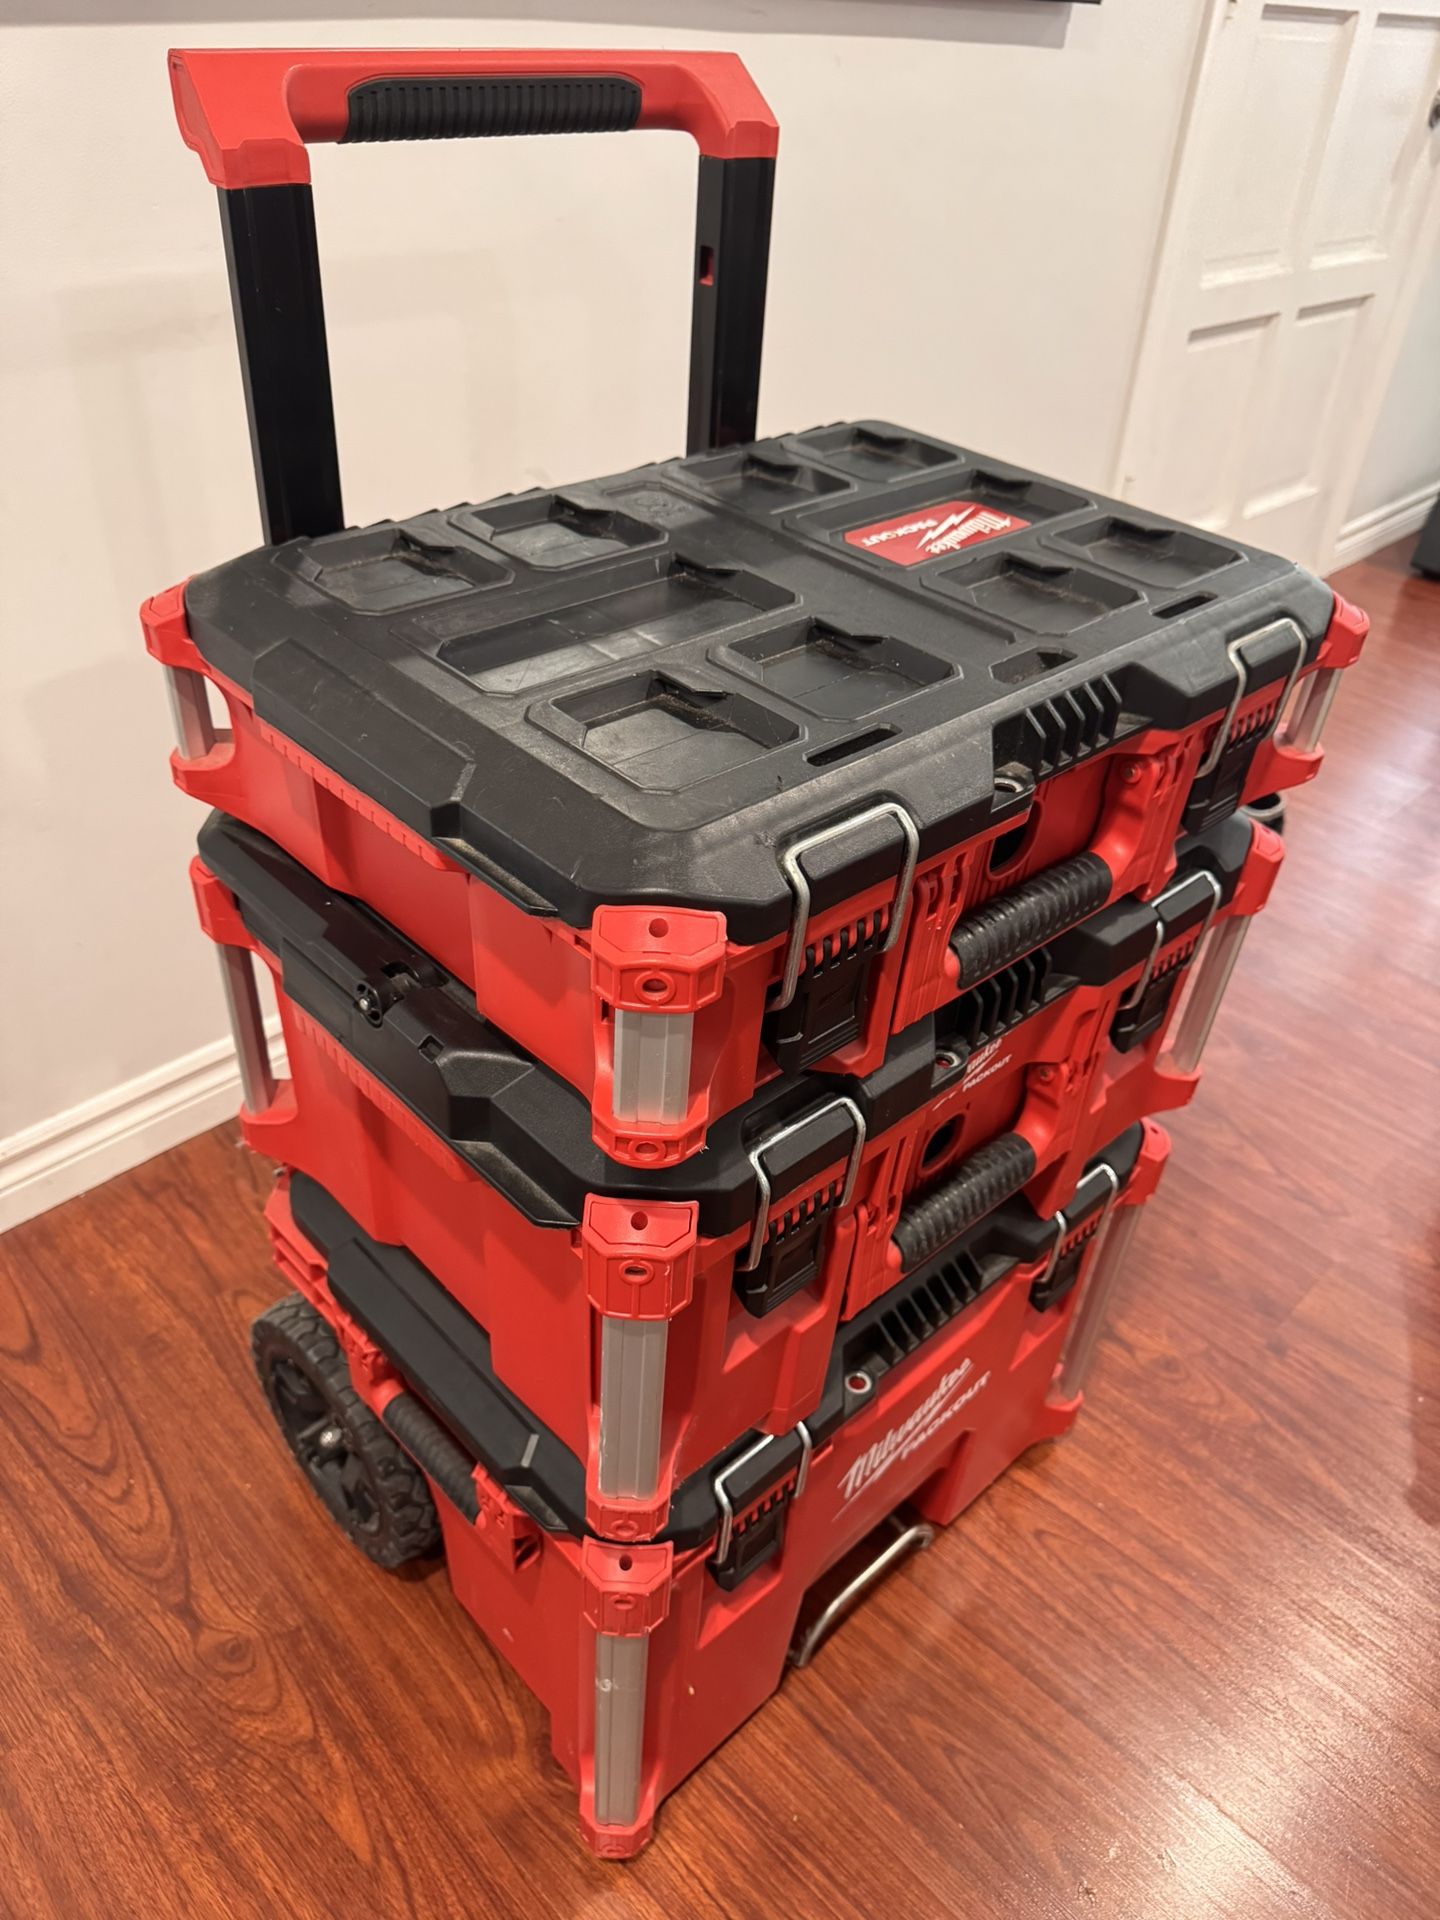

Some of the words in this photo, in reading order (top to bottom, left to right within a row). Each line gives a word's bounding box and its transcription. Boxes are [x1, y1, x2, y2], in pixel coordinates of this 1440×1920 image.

[861, 518, 939, 547] PACKOUT
[925, 511, 1012, 554] Milwaukee
[962, 1054, 1012, 1092] PACKOUT
[837, 1357, 972, 1499] Milwaukee
[901, 1370, 992, 1461] PACKOUT
